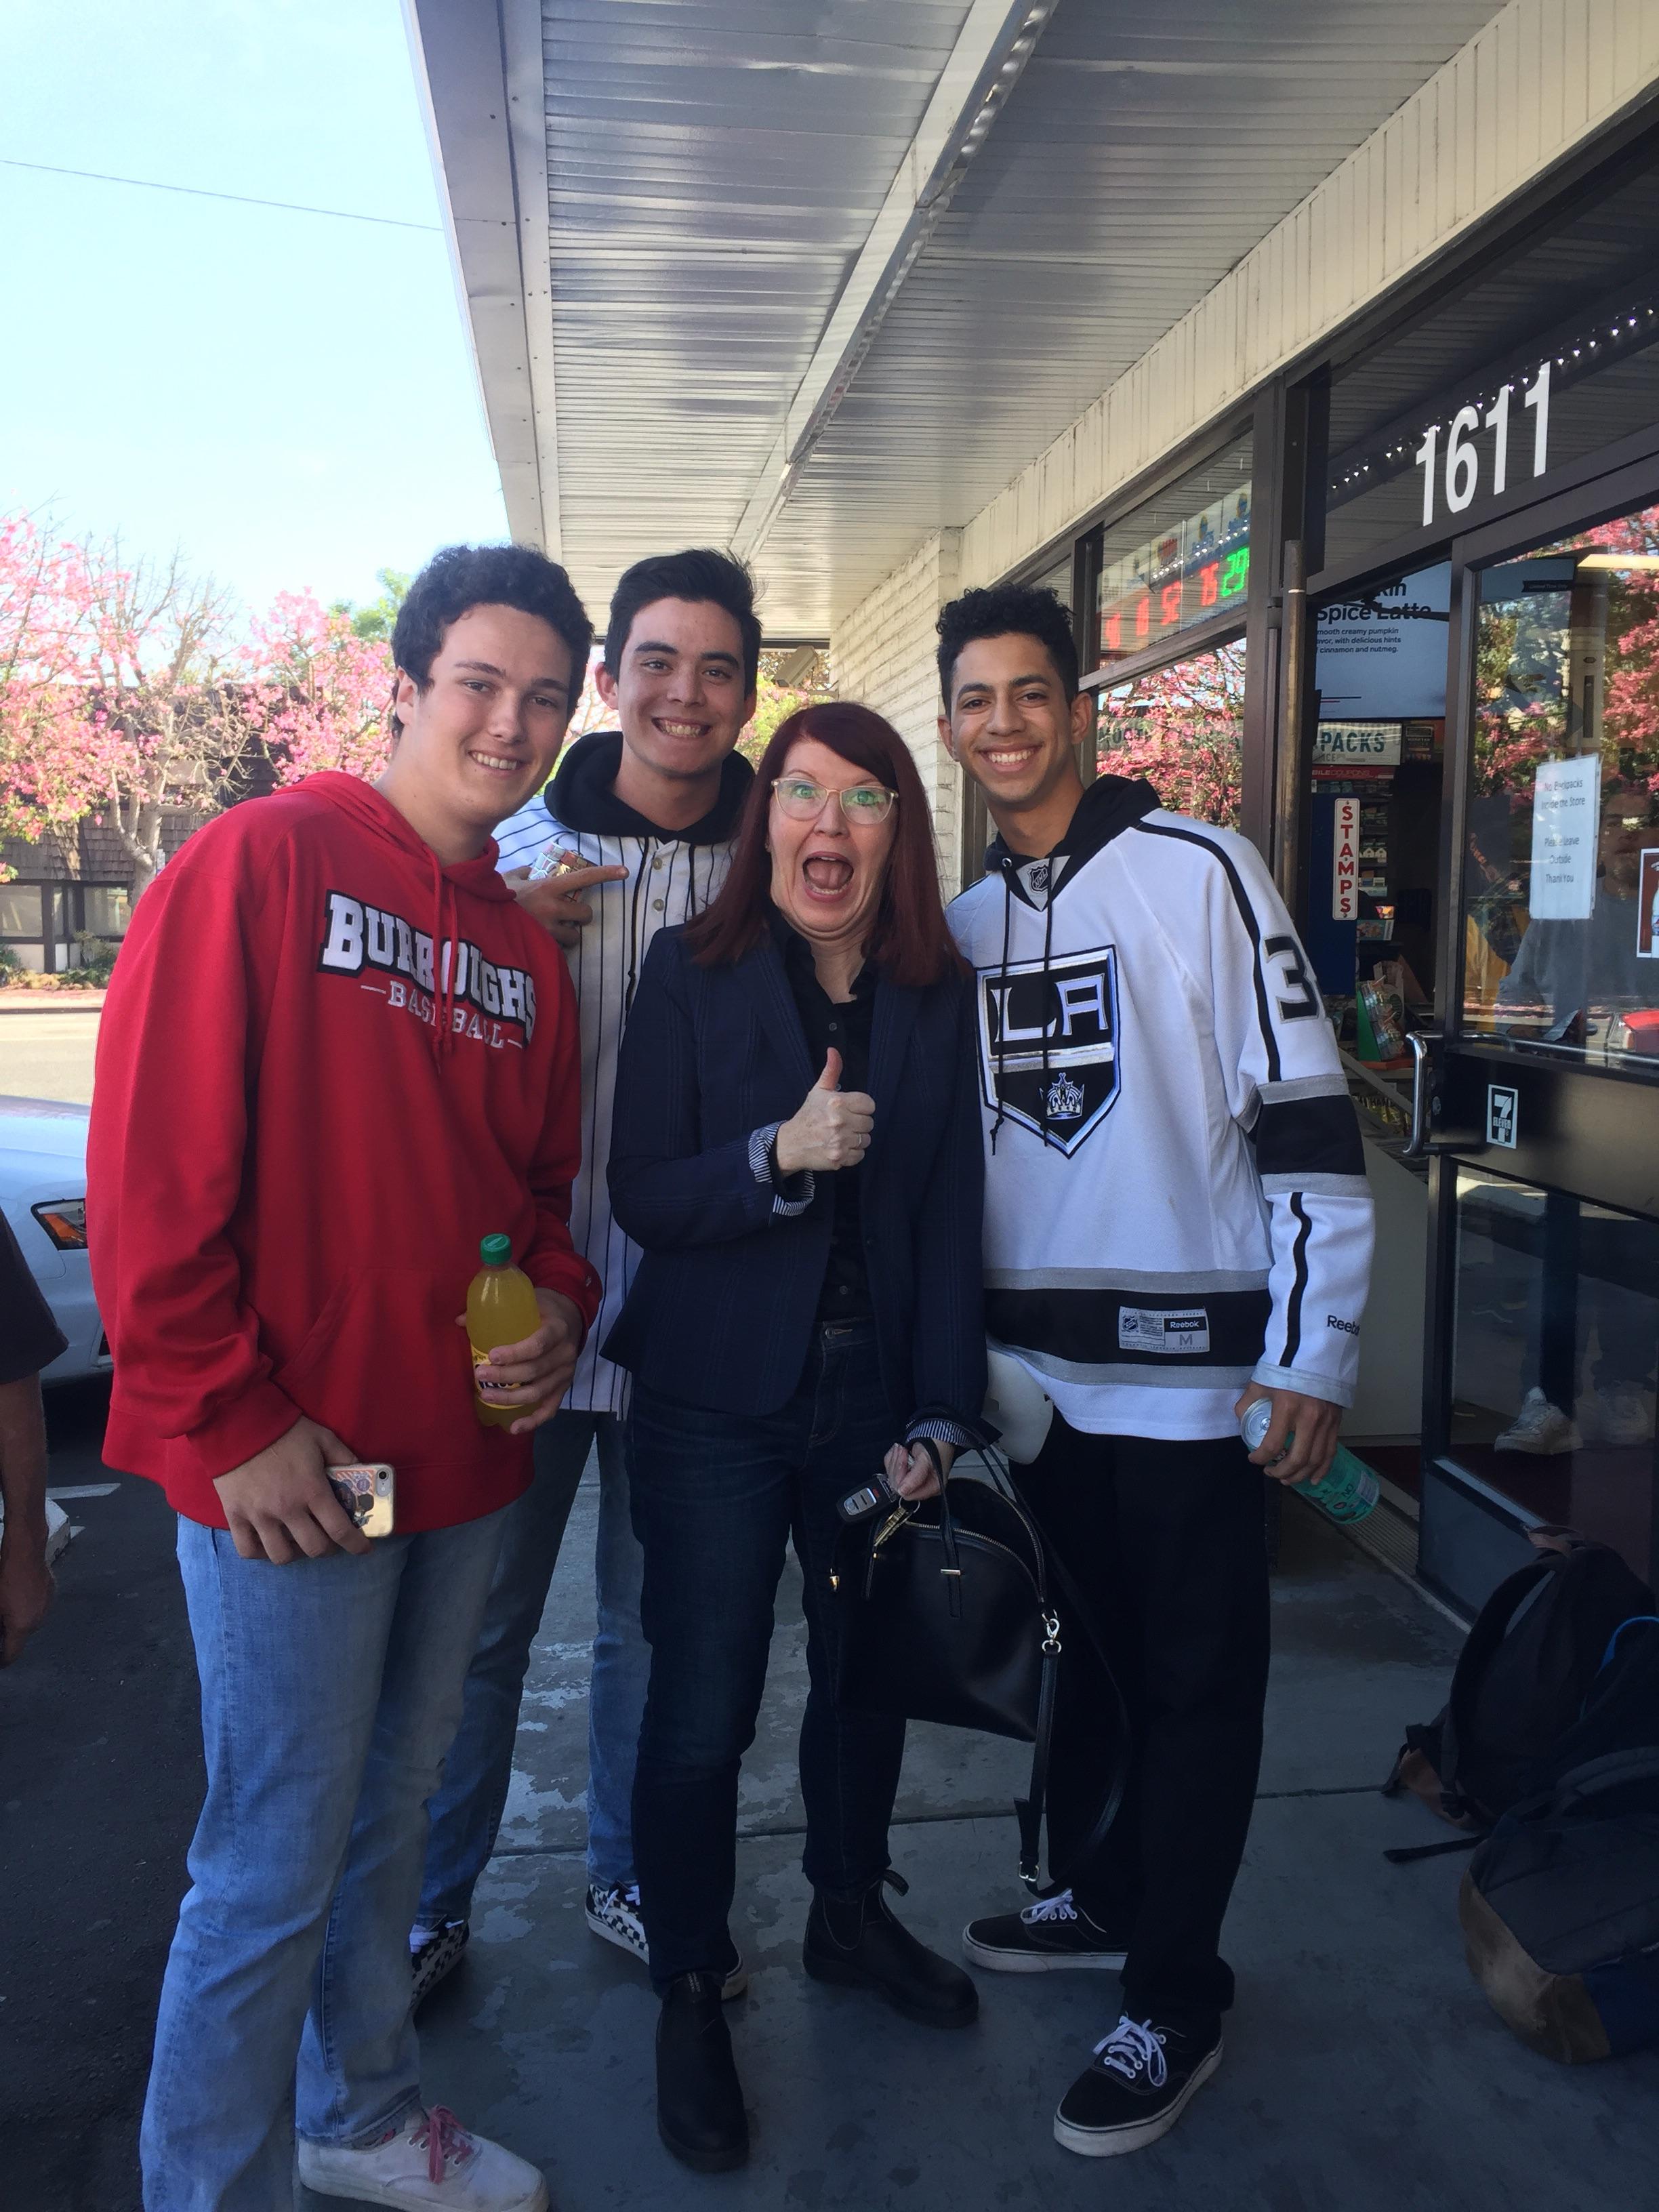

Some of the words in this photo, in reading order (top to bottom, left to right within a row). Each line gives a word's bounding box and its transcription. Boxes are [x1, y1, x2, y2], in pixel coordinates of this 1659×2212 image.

[1416, 361, 1551, 527] 1611
[1317, 605, 1372, 625] Spice
[1321, 731, 1385, 753] PACKS
[1570, 797, 1585, 807] Store
[1338, 805, 1355, 913] STAMPS
[990, 972, 1109, 1043] LA
[1170, 1320, 1200, 1329] Reebok
[1179, 1334, 1193, 1346] M
